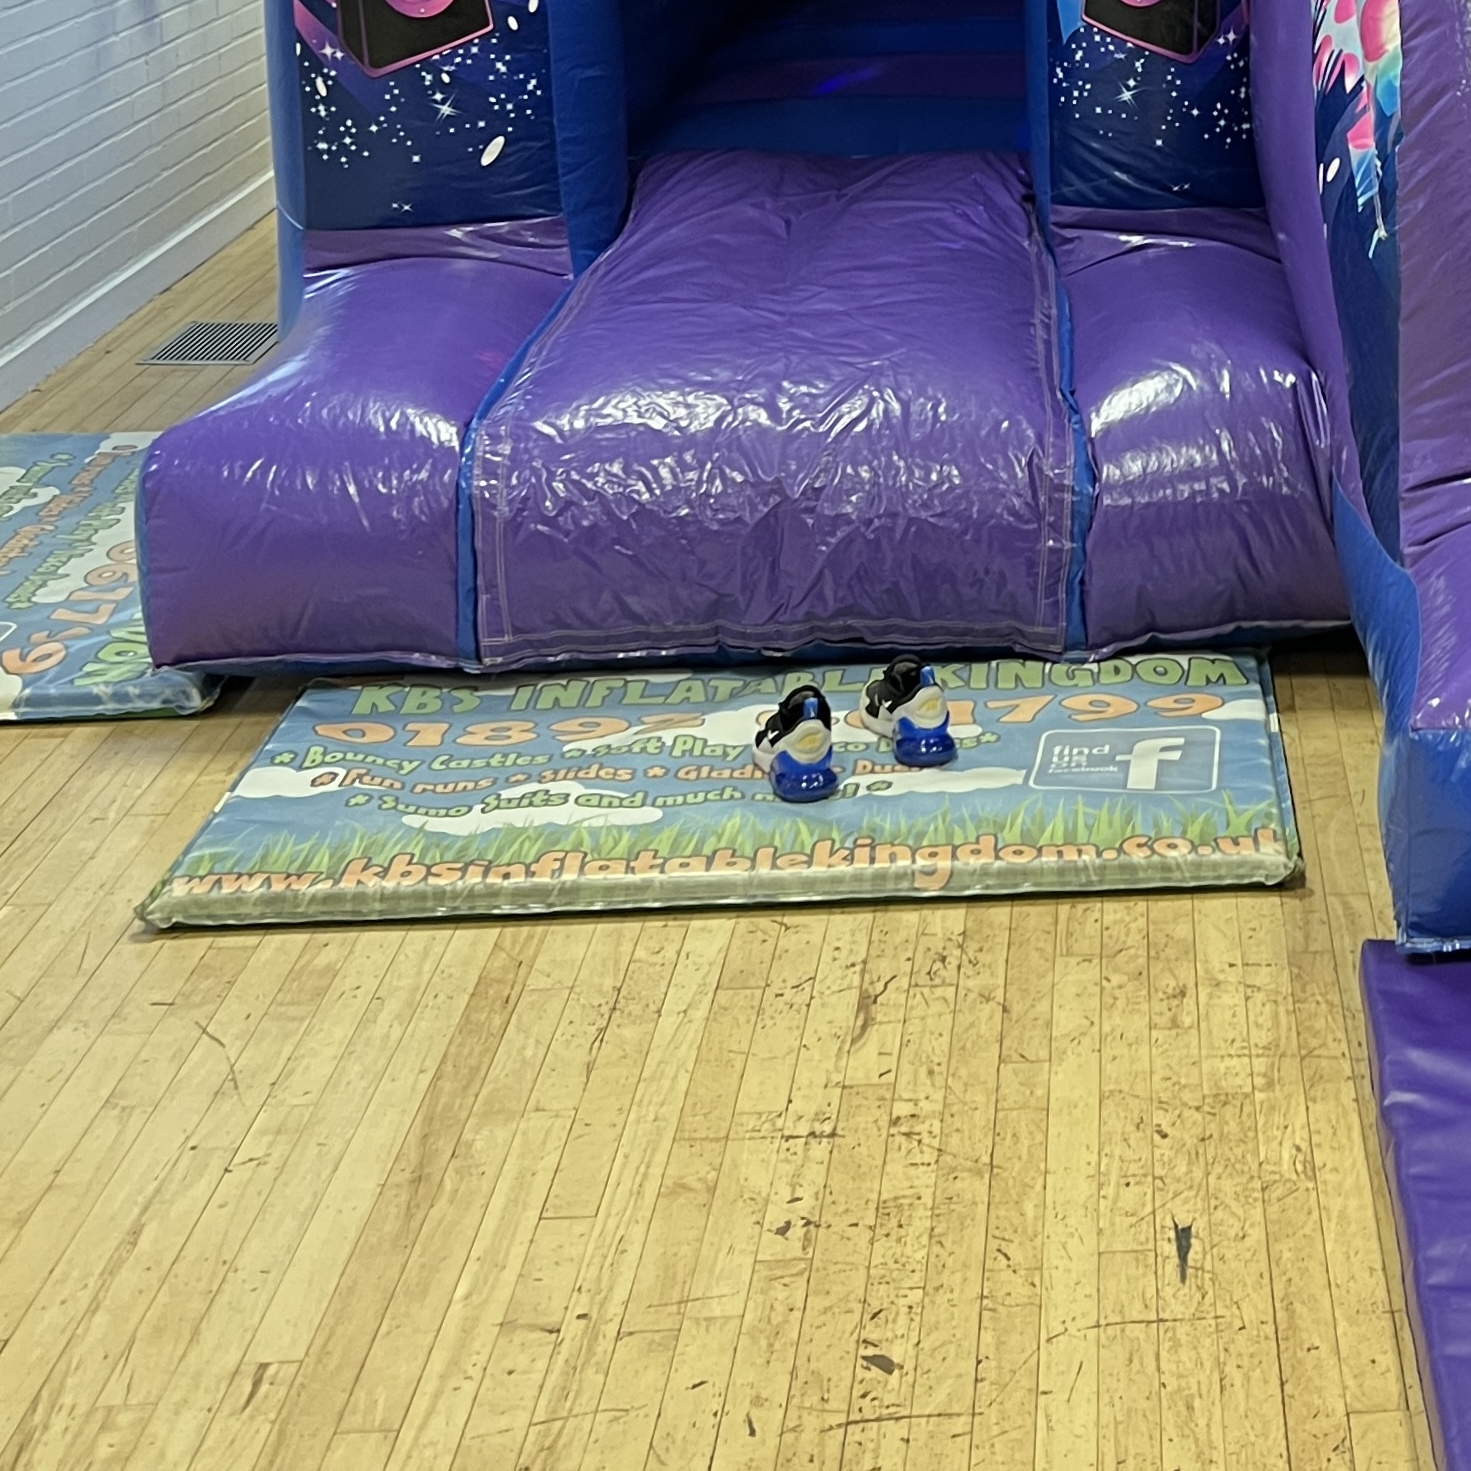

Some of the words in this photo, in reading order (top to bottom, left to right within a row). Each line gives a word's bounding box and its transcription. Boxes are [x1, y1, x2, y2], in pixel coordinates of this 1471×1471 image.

[352, 684, 482, 715] KBS
[509, 666, 892, 713] INFLATABL
[313, 712, 706, 748] 01892
[301, 744, 424, 775] Bouncy
[429, 752, 552, 772] Castles
[671, 734, 746, 762] Play
[1052, 744, 1111, 755] find
[339, 768, 404, 791] Fun
[411, 777, 497, 795] runs
[378, 794, 474, 818] Sumo
[481, 790, 570, 813] Suits
[574, 791, 646, 808] and
[653, 785, 746, 808] much
[170, 827, 1283, 891] www.kbsinflatablekingdom.co.uk
